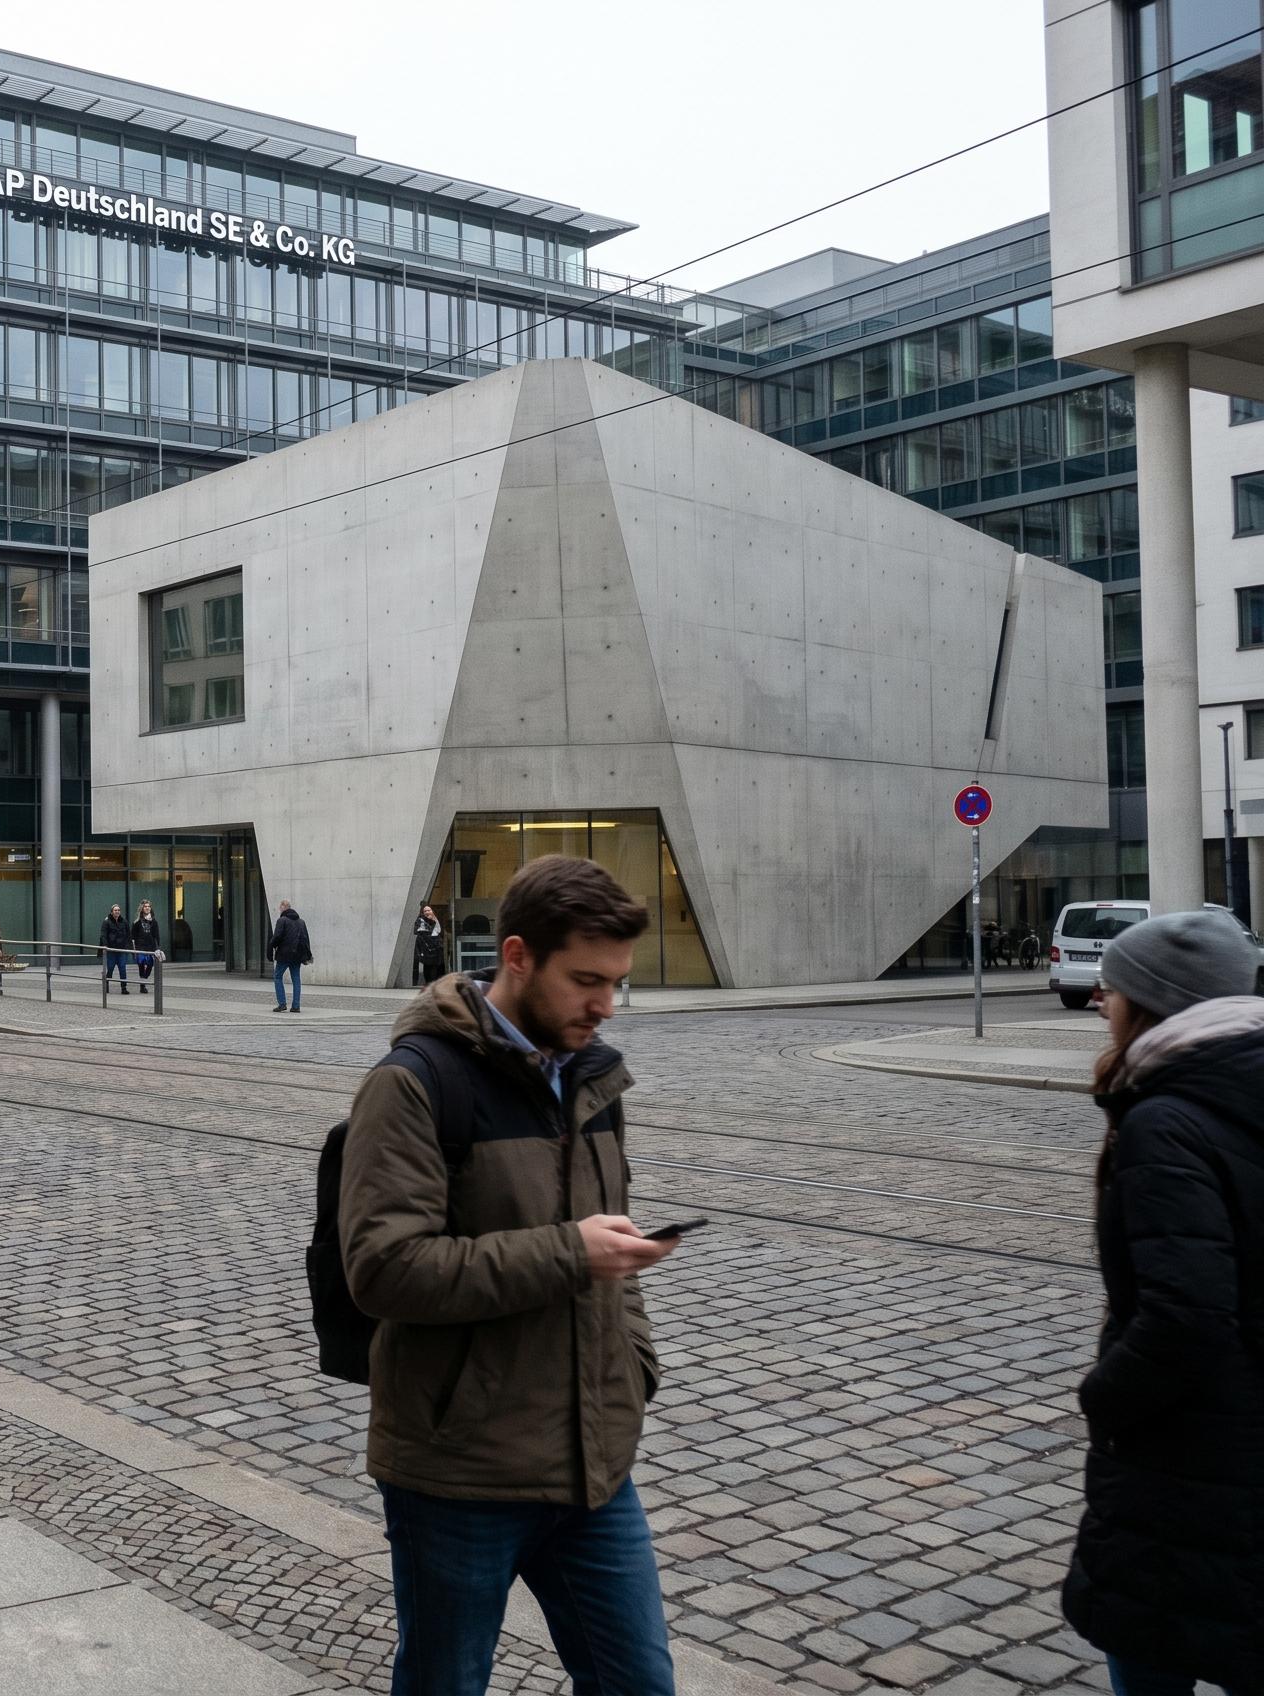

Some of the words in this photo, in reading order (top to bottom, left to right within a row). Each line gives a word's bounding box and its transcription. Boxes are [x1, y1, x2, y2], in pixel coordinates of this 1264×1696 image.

[33, 173, 203, 236] Deutschland
[210, 211, 244, 244] SE
[249, 220, 270, 249] &
[276, 225, 315, 258] Co.
[322, 234, 356, 266] KG
